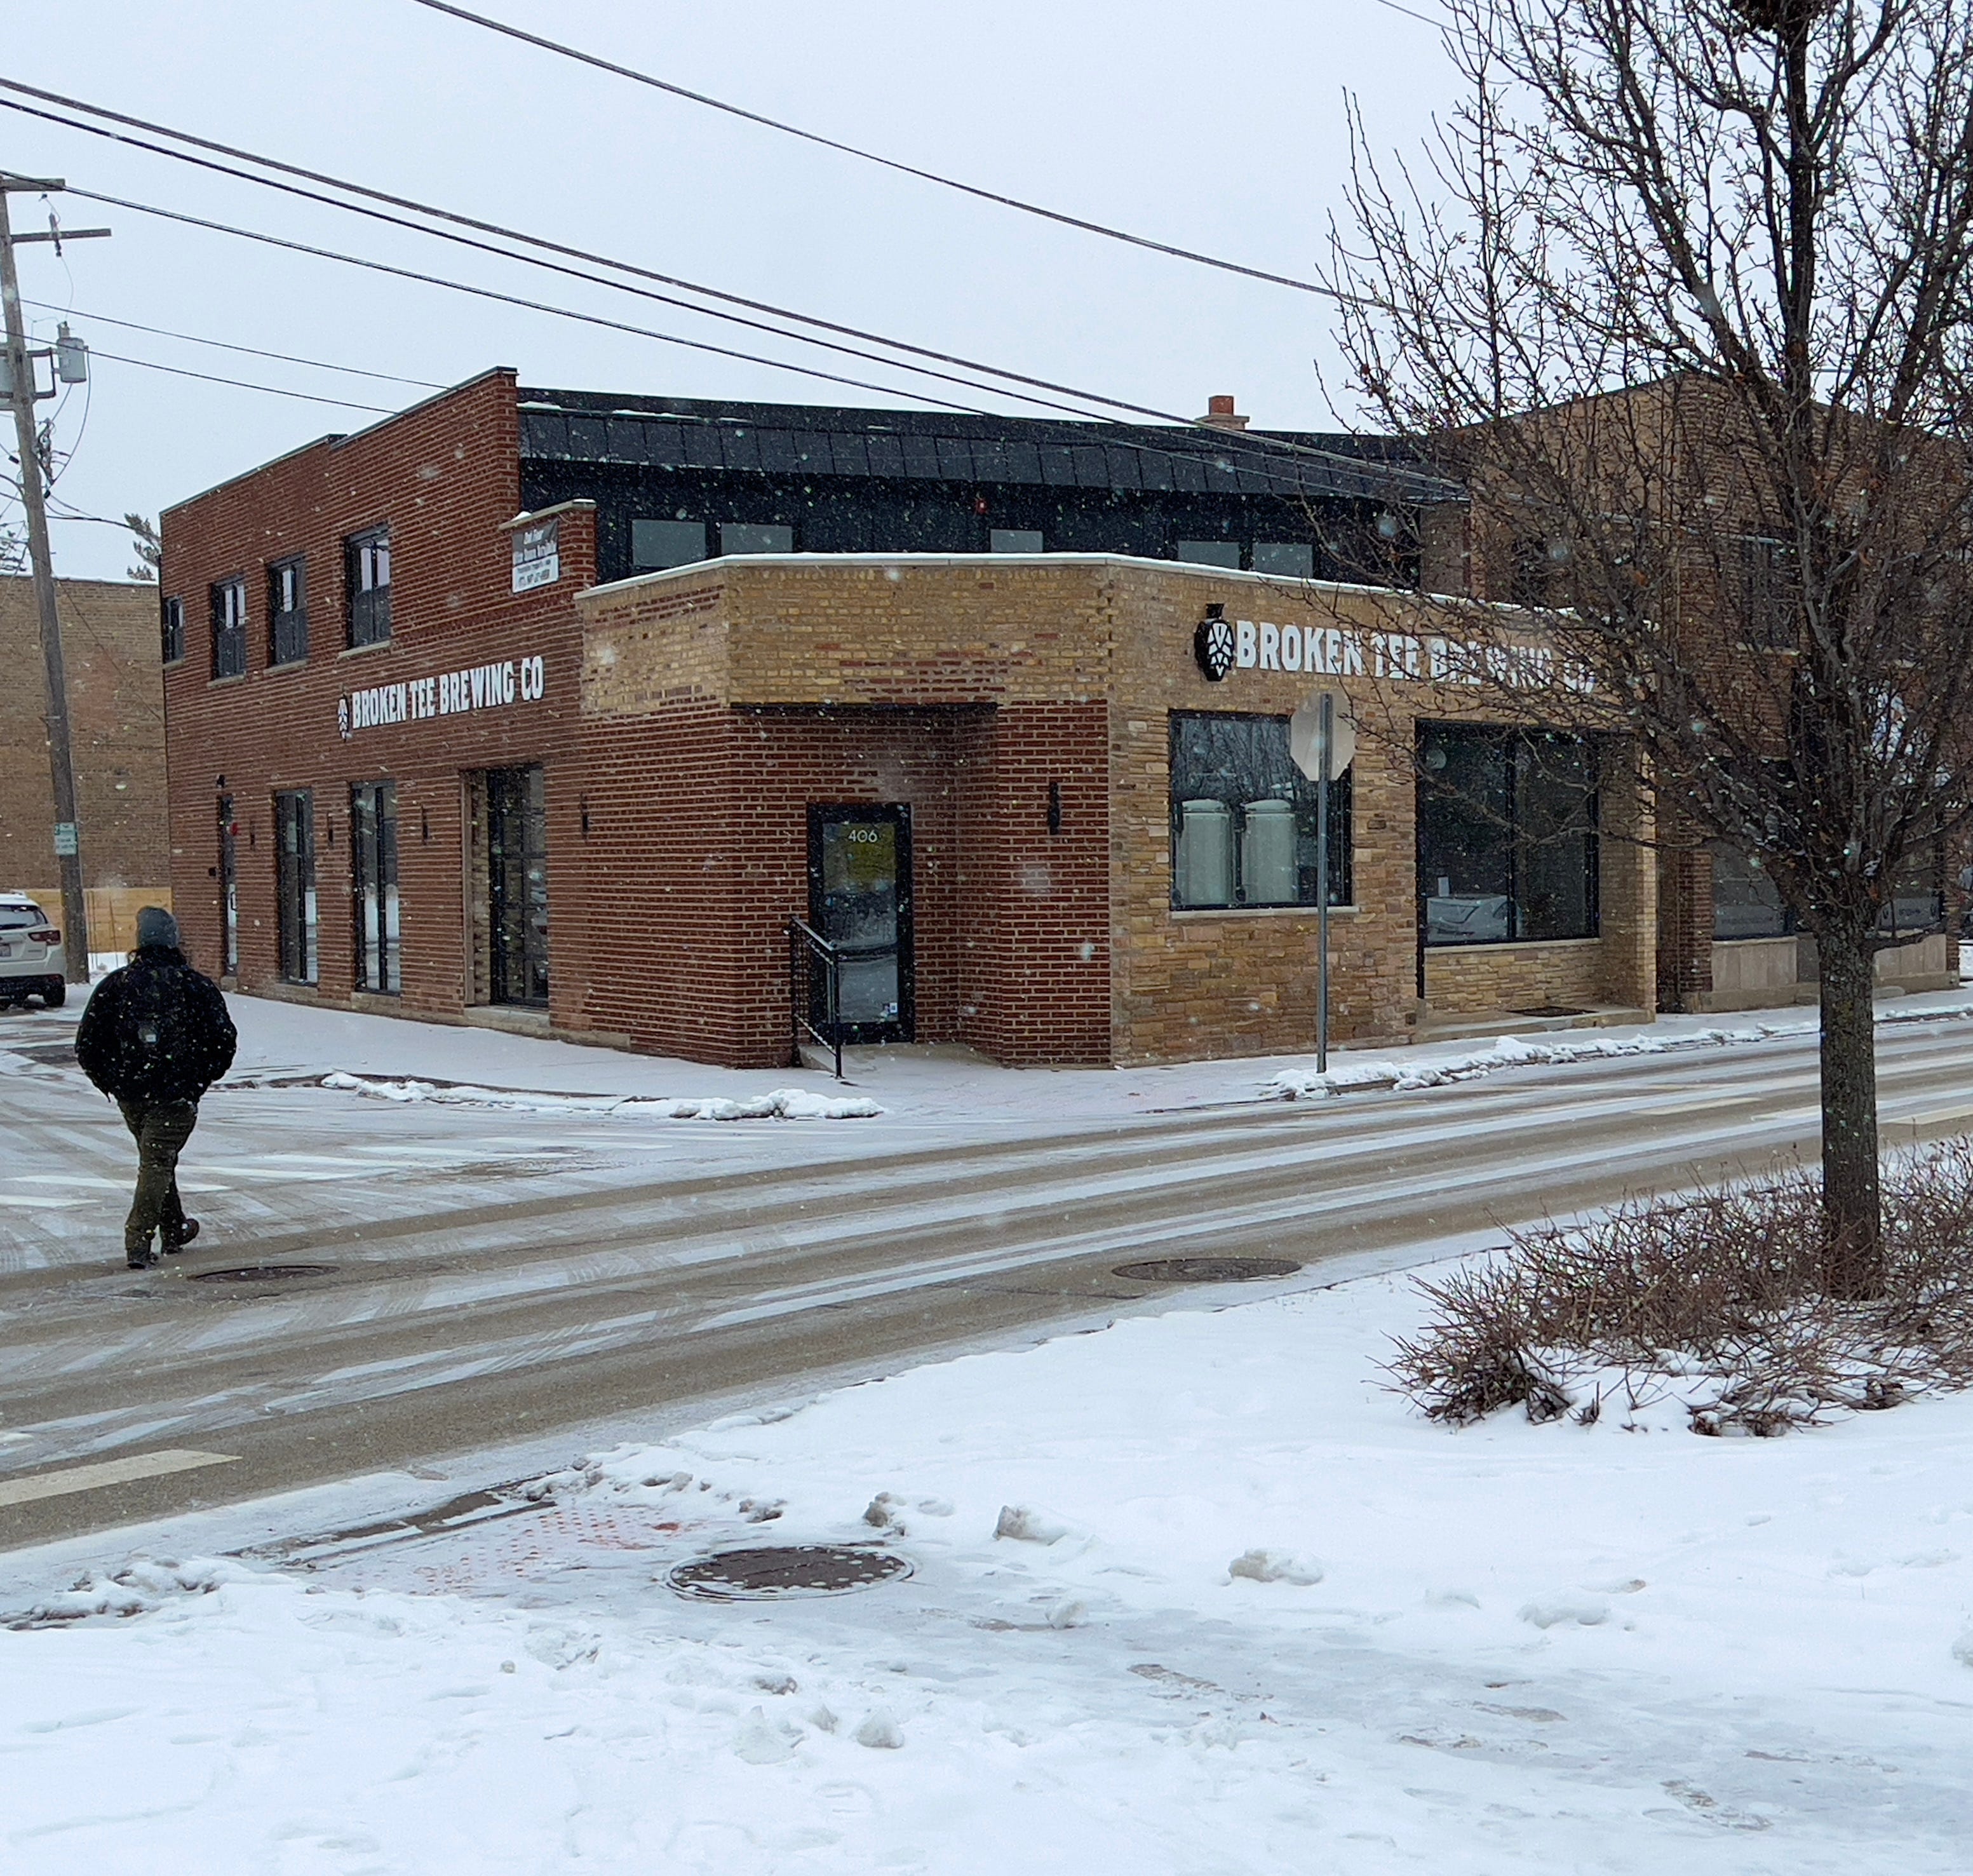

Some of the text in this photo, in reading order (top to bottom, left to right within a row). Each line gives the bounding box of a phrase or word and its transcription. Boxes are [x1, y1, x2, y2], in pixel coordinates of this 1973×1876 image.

[1236, 620, 1363, 677] BROKEN
[1370, 631, 1420, 681] TEE
[352, 656, 544, 729] BROKEN TEE BREWING CO
[848, 829, 877, 842] 406
